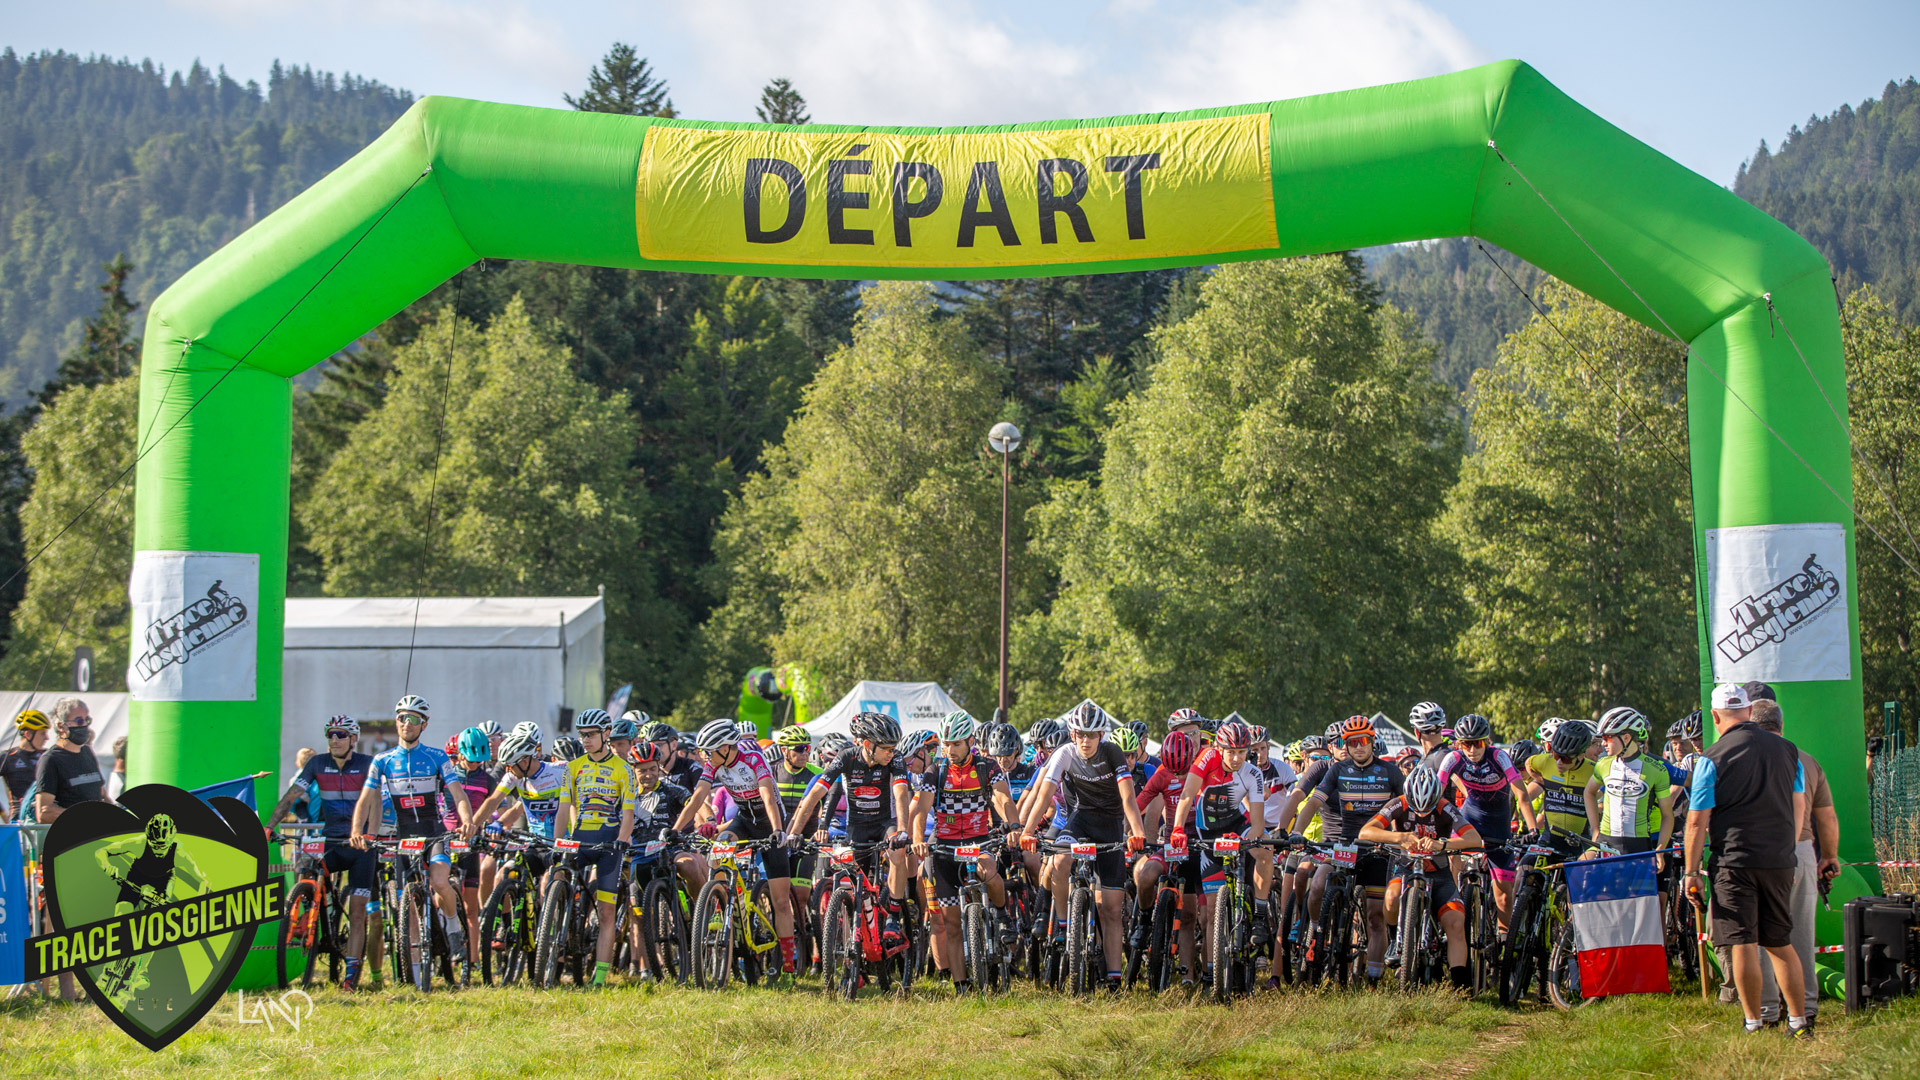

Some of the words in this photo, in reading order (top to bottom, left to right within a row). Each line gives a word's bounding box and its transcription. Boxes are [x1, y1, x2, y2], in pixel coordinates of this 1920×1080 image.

[743, 145, 1160, 248] DÉPART
[146, 597, 217, 657] Trace
[1716, 577, 1840, 664] Vosgienne
[1729, 573, 1811, 636] Trace
[135, 602, 248, 682] Vosgienne
[905, 711, 946, 719] VOSGES
[1337, 850, 1351, 859] 315
